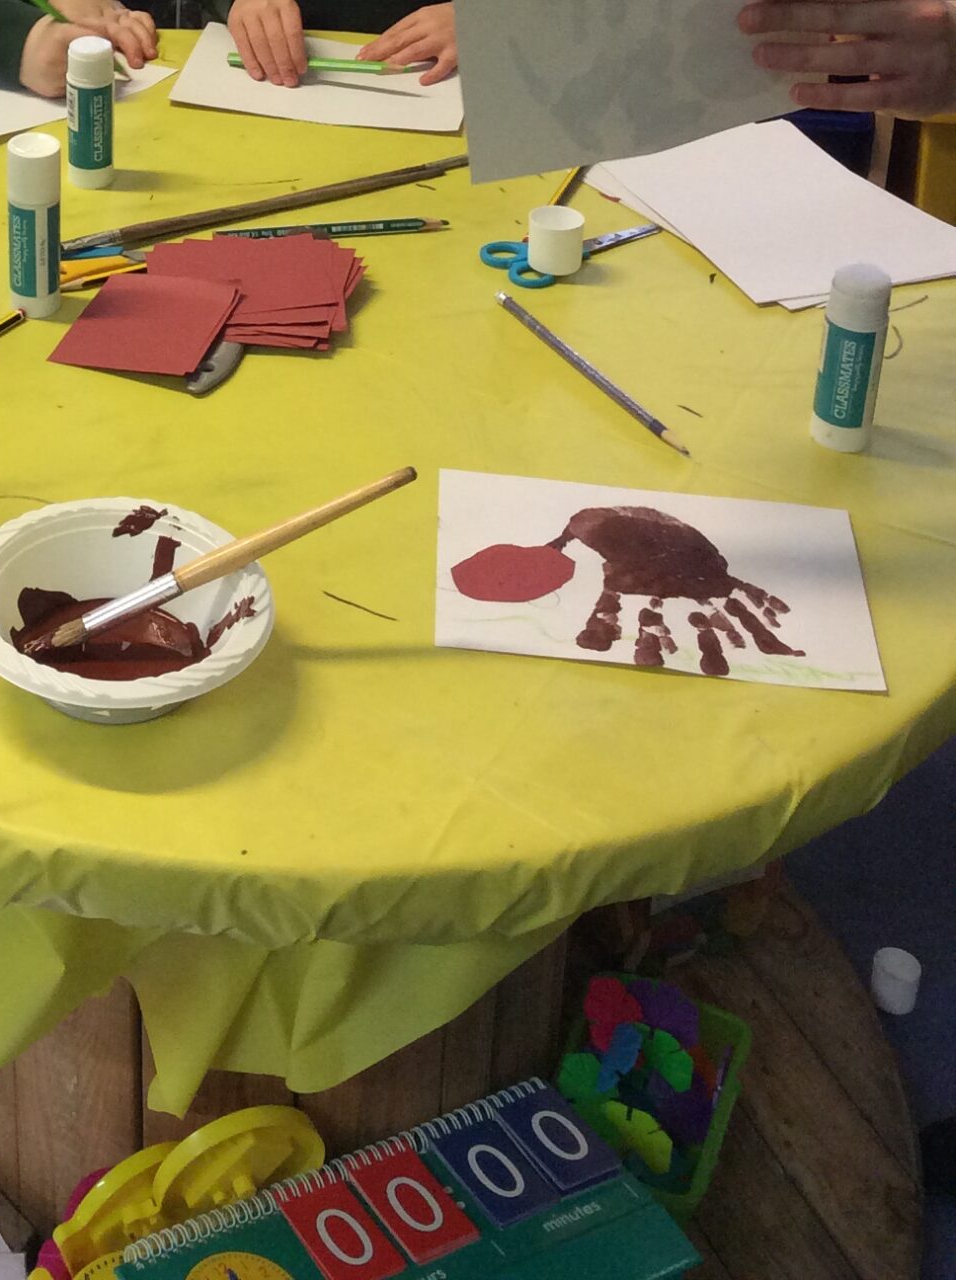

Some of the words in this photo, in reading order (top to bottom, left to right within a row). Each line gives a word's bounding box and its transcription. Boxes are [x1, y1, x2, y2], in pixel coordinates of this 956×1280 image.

[94, 94, 104, 163] CLASSMATES
[13, 215, 22, 288] CLASSMATES
[834, 340, 857, 420] CLASSMATES
[316, 1208, 373, 1266] 0
[386, 1176, 444, 1232] 0
[467, 1144, 525, 1198] 0
[531, 1110, 589, 1161] 0
[543, 1200, 603, 1233] minutes
